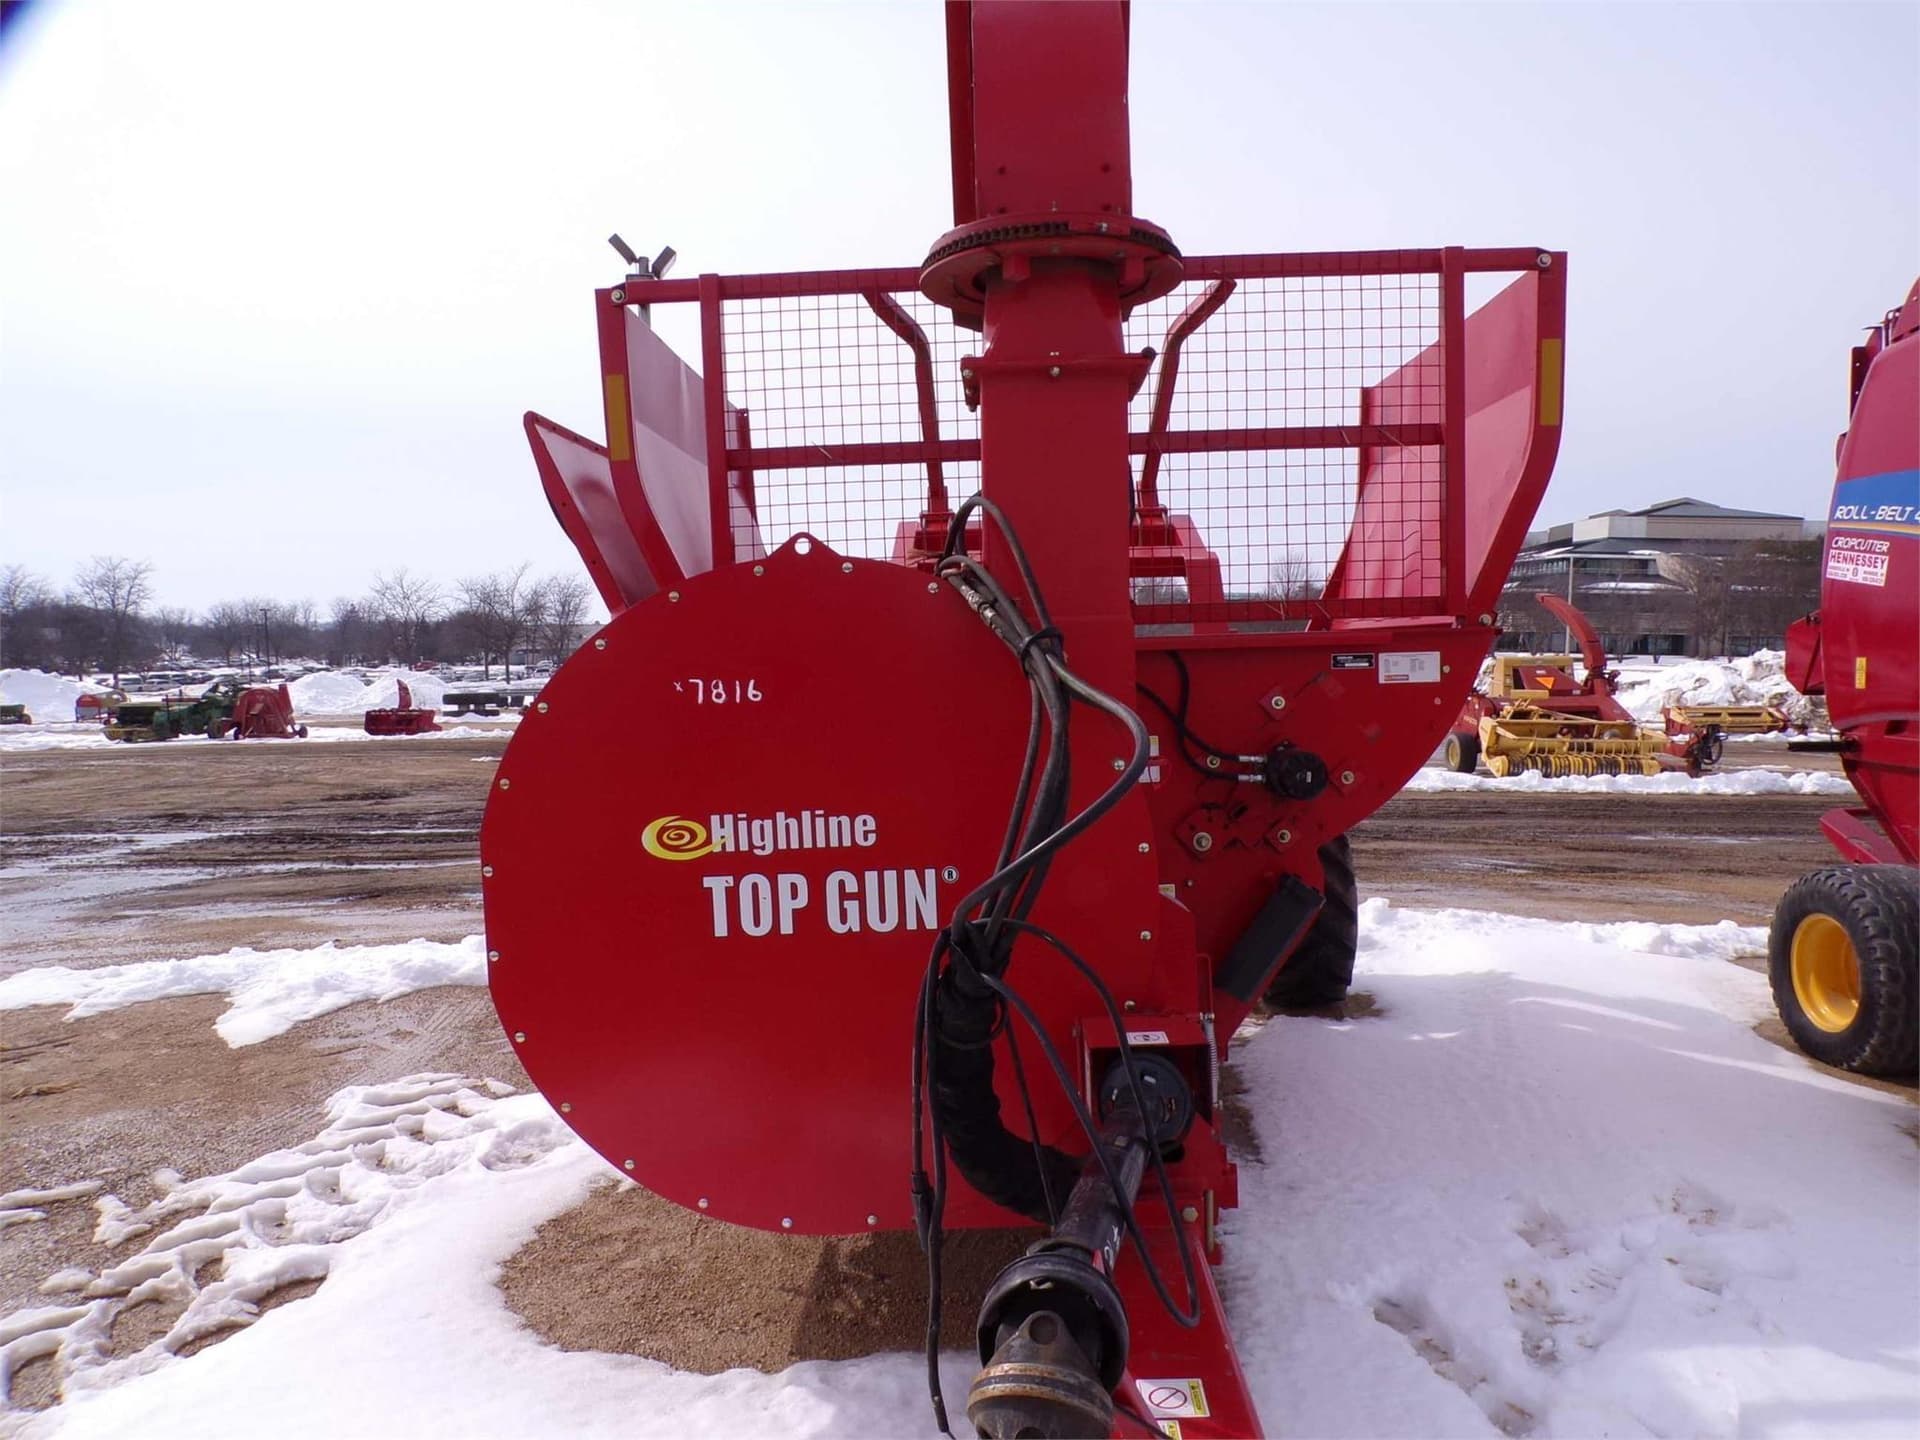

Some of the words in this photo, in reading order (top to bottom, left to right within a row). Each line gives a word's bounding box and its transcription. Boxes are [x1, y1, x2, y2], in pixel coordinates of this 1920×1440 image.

[1834, 504, 1914, 521] ROLL-BELT
[1832, 537, 1890, 553] CROPCUTTER
[1830, 551, 1886, 570] HENNESSEY
[709, 810, 877, 856] Highline
[702, 872, 808, 937] TOP
